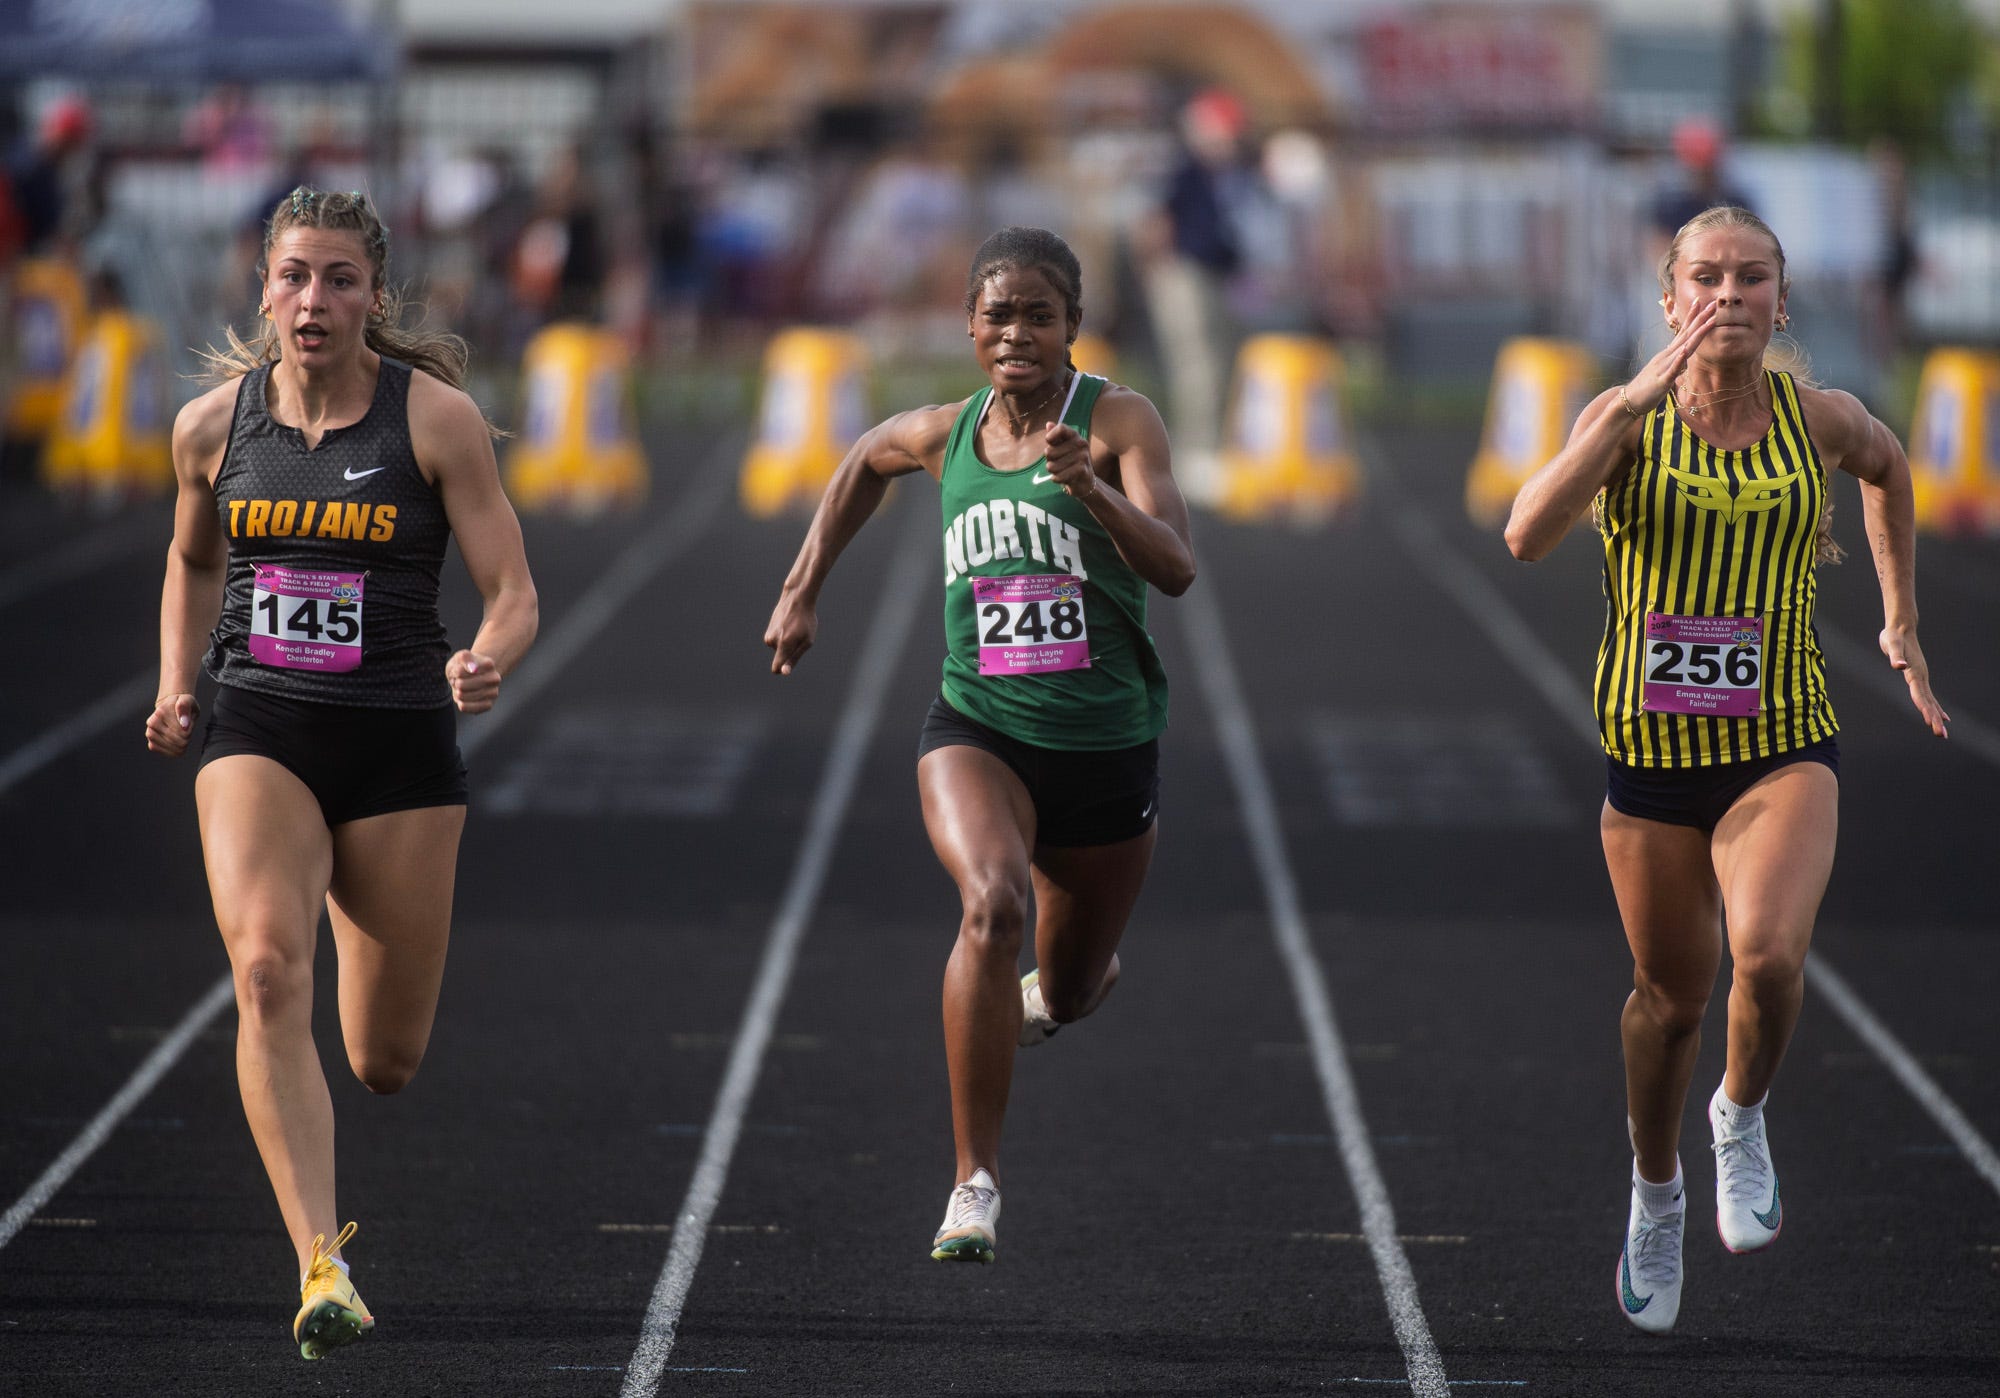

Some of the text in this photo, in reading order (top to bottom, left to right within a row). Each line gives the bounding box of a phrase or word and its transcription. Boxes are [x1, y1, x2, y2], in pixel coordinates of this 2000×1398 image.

[229, 500, 398, 542] TROJANS
[946, 499, 1088, 586] NORTH
[281, 577, 303, 585] TRACK
[279, 583, 331, 593] CHAMPIONSHIP
[1003, 589, 1052, 597] CHAMPIONSHIP
[259, 594, 359, 643] 145
[982, 600, 1083, 643] 248
[304, 647, 336, 658] Bradley
[1039, 648, 1064, 657] Layne
[286, 654, 324, 664] Chesterton
[1009, 659, 1040, 667] Evansville
[1649, 642, 1758, 687] 256
[1676, 690, 1730, 701] Emma Walter
[1689, 699, 1717, 708] Fairfield
